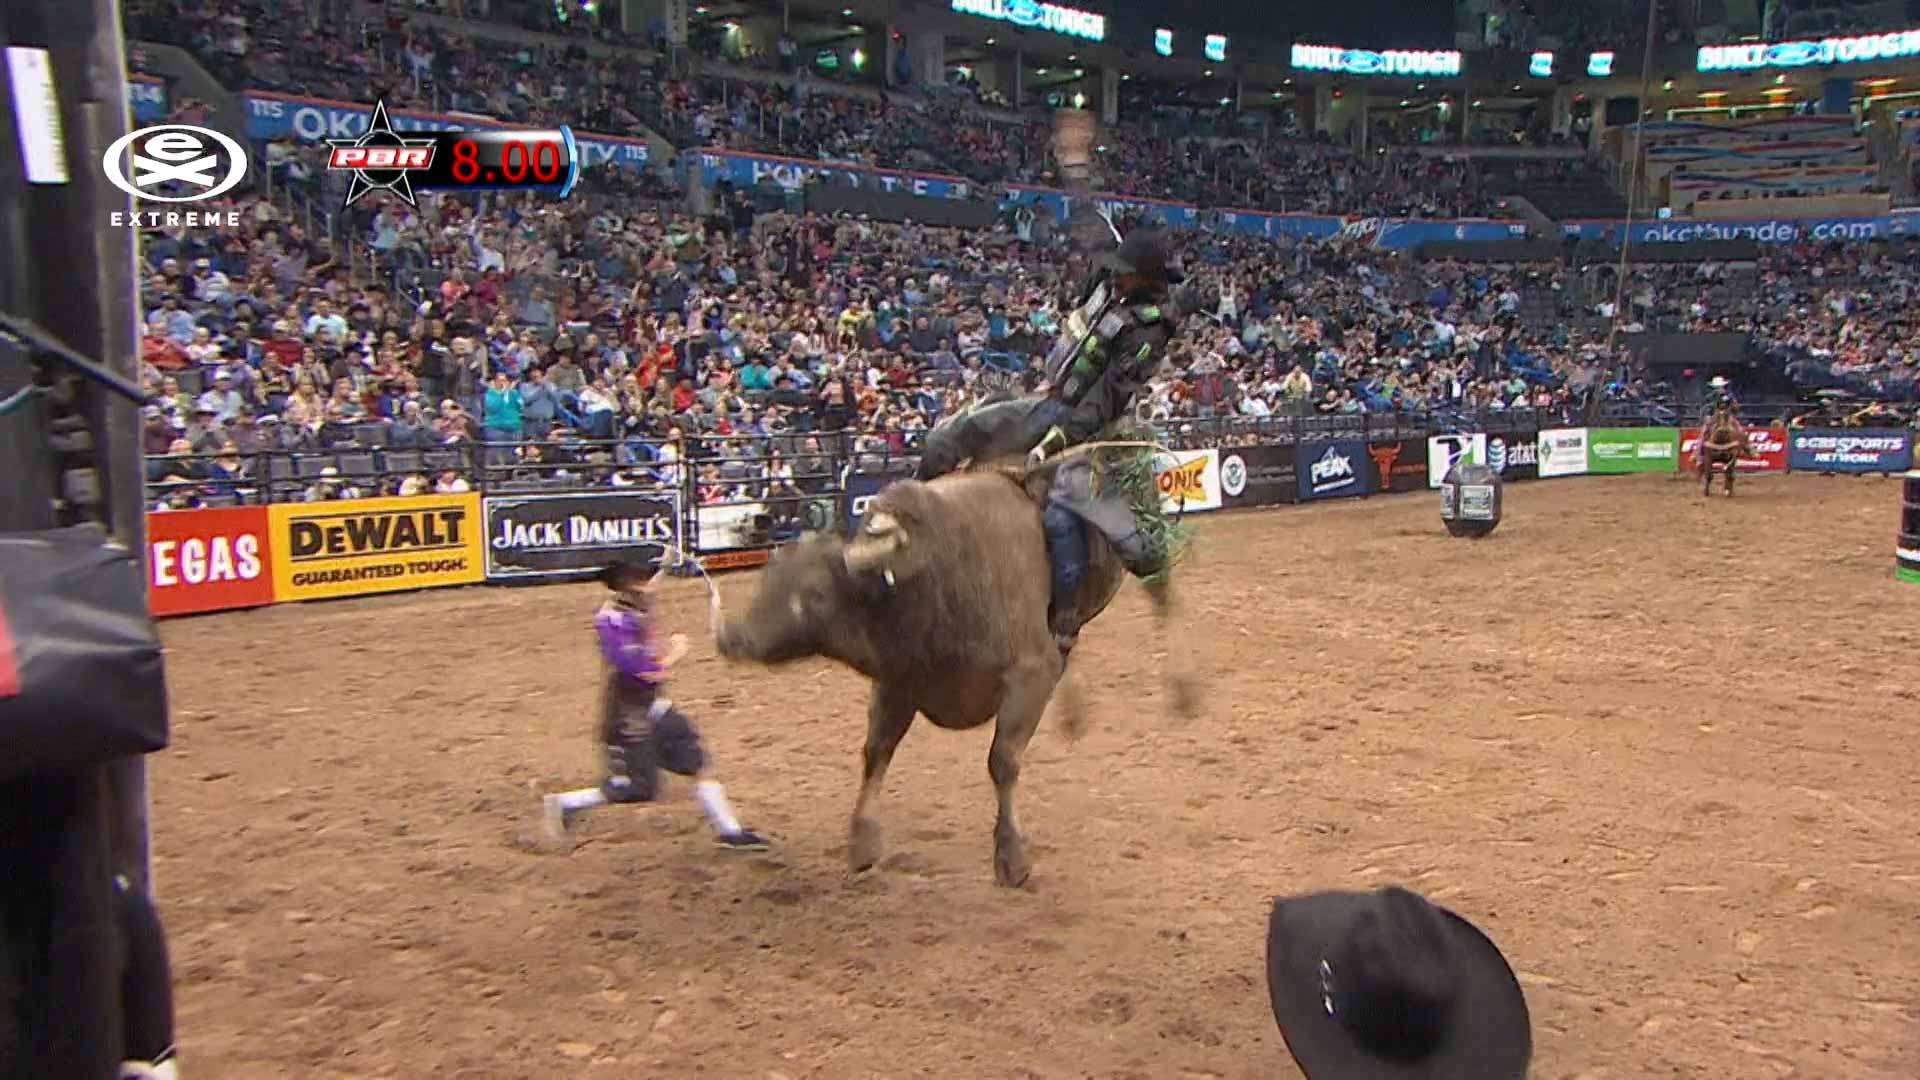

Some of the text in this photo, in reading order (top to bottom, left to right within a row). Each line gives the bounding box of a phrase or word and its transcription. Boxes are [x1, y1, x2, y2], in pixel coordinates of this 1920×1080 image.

[1041, 3, 1104, 40] TOUGH
[1820, 27, 1920, 63] TOUGH
[1380, 51, 1461, 75] TOUGH
[1837, 437, 1904, 452] SPORTS
[1311, 456, 1355, 484] PEAK
[1814, 452, 1881, 464] NETWORK
[492, 519, 562, 549] JACK
[292, 564, 404, 587] GUARANTEED
